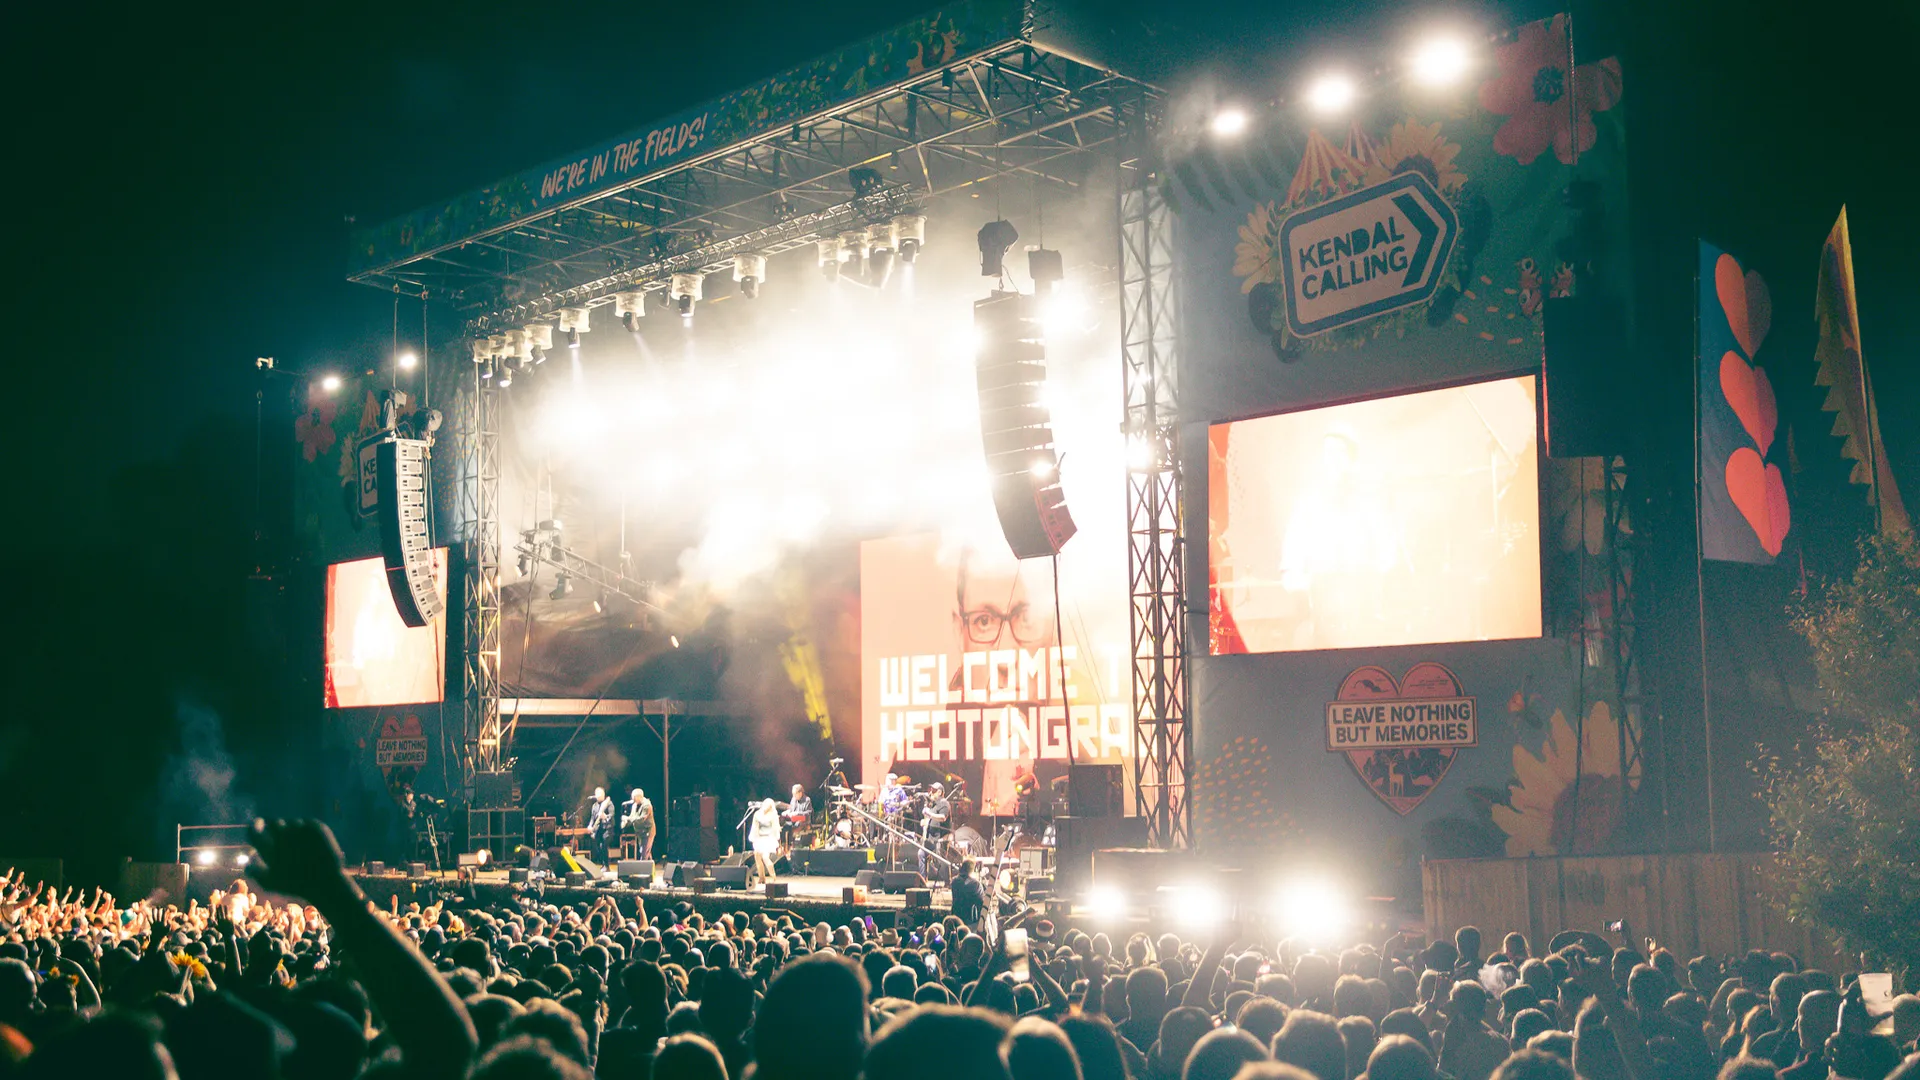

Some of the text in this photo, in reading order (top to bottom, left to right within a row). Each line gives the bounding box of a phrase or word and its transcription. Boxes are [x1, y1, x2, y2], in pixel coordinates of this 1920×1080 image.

[541, 112, 708, 198] WE'RE IN THE FIELDS!
[1299, 216, 1405, 273] KENDAL
[1302, 246, 1408, 300] CALLING
[879, 645, 1078, 707] WELCOME
[1332, 702, 1471, 725] LEAVE NOTHING
[1336, 722, 1468, 743] BUT MEMORIES
